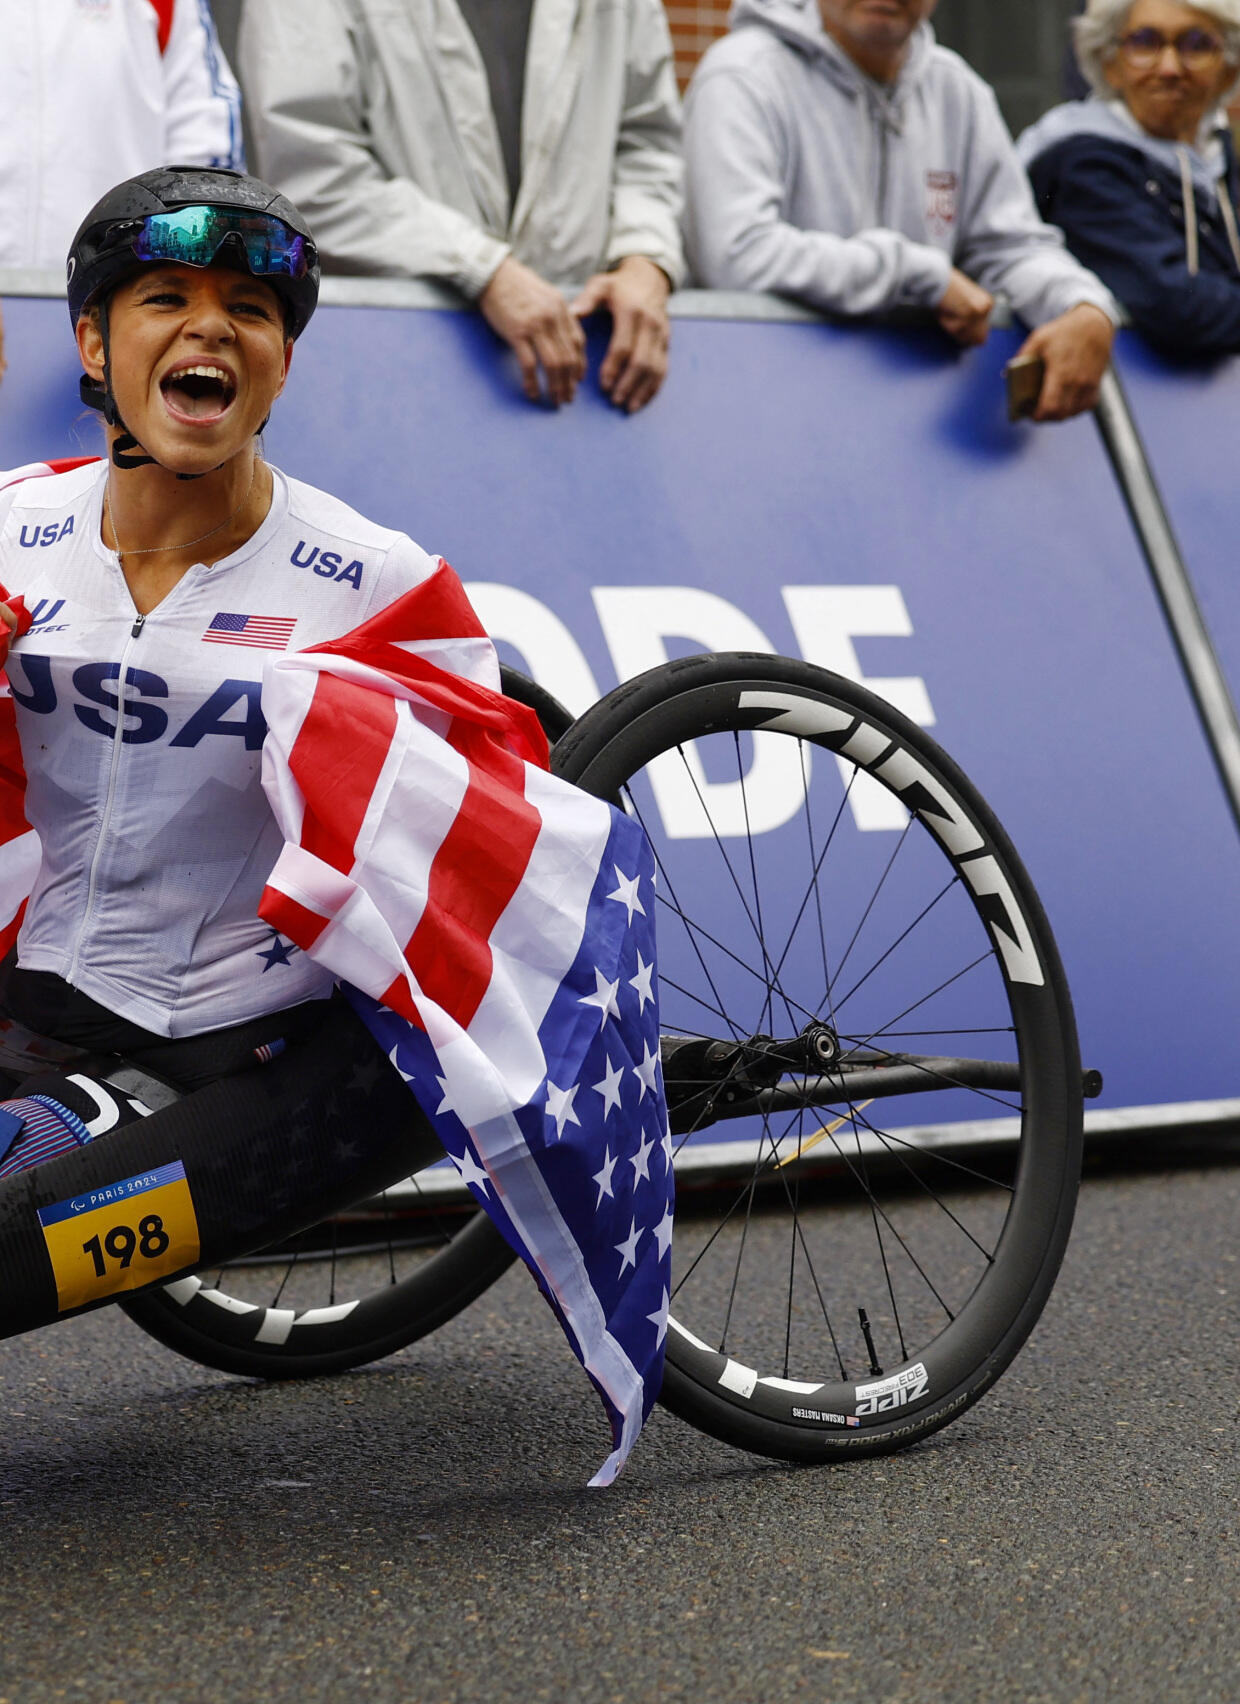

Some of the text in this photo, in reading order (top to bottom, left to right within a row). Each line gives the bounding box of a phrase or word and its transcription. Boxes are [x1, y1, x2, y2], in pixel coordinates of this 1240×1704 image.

[19, 514, 75, 548] USA
[290, 541, 364, 590] USA
[10, 653, 268, 752] USA
[90, 1175, 158, 1204] PARIS 2024
[82, 1214, 170, 1278] 198
[899, 1366, 923, 1386] 303
[856, 1377, 929, 1416] ZIPP
[793, 1407, 844, 1424] OKSANA MASTERS
